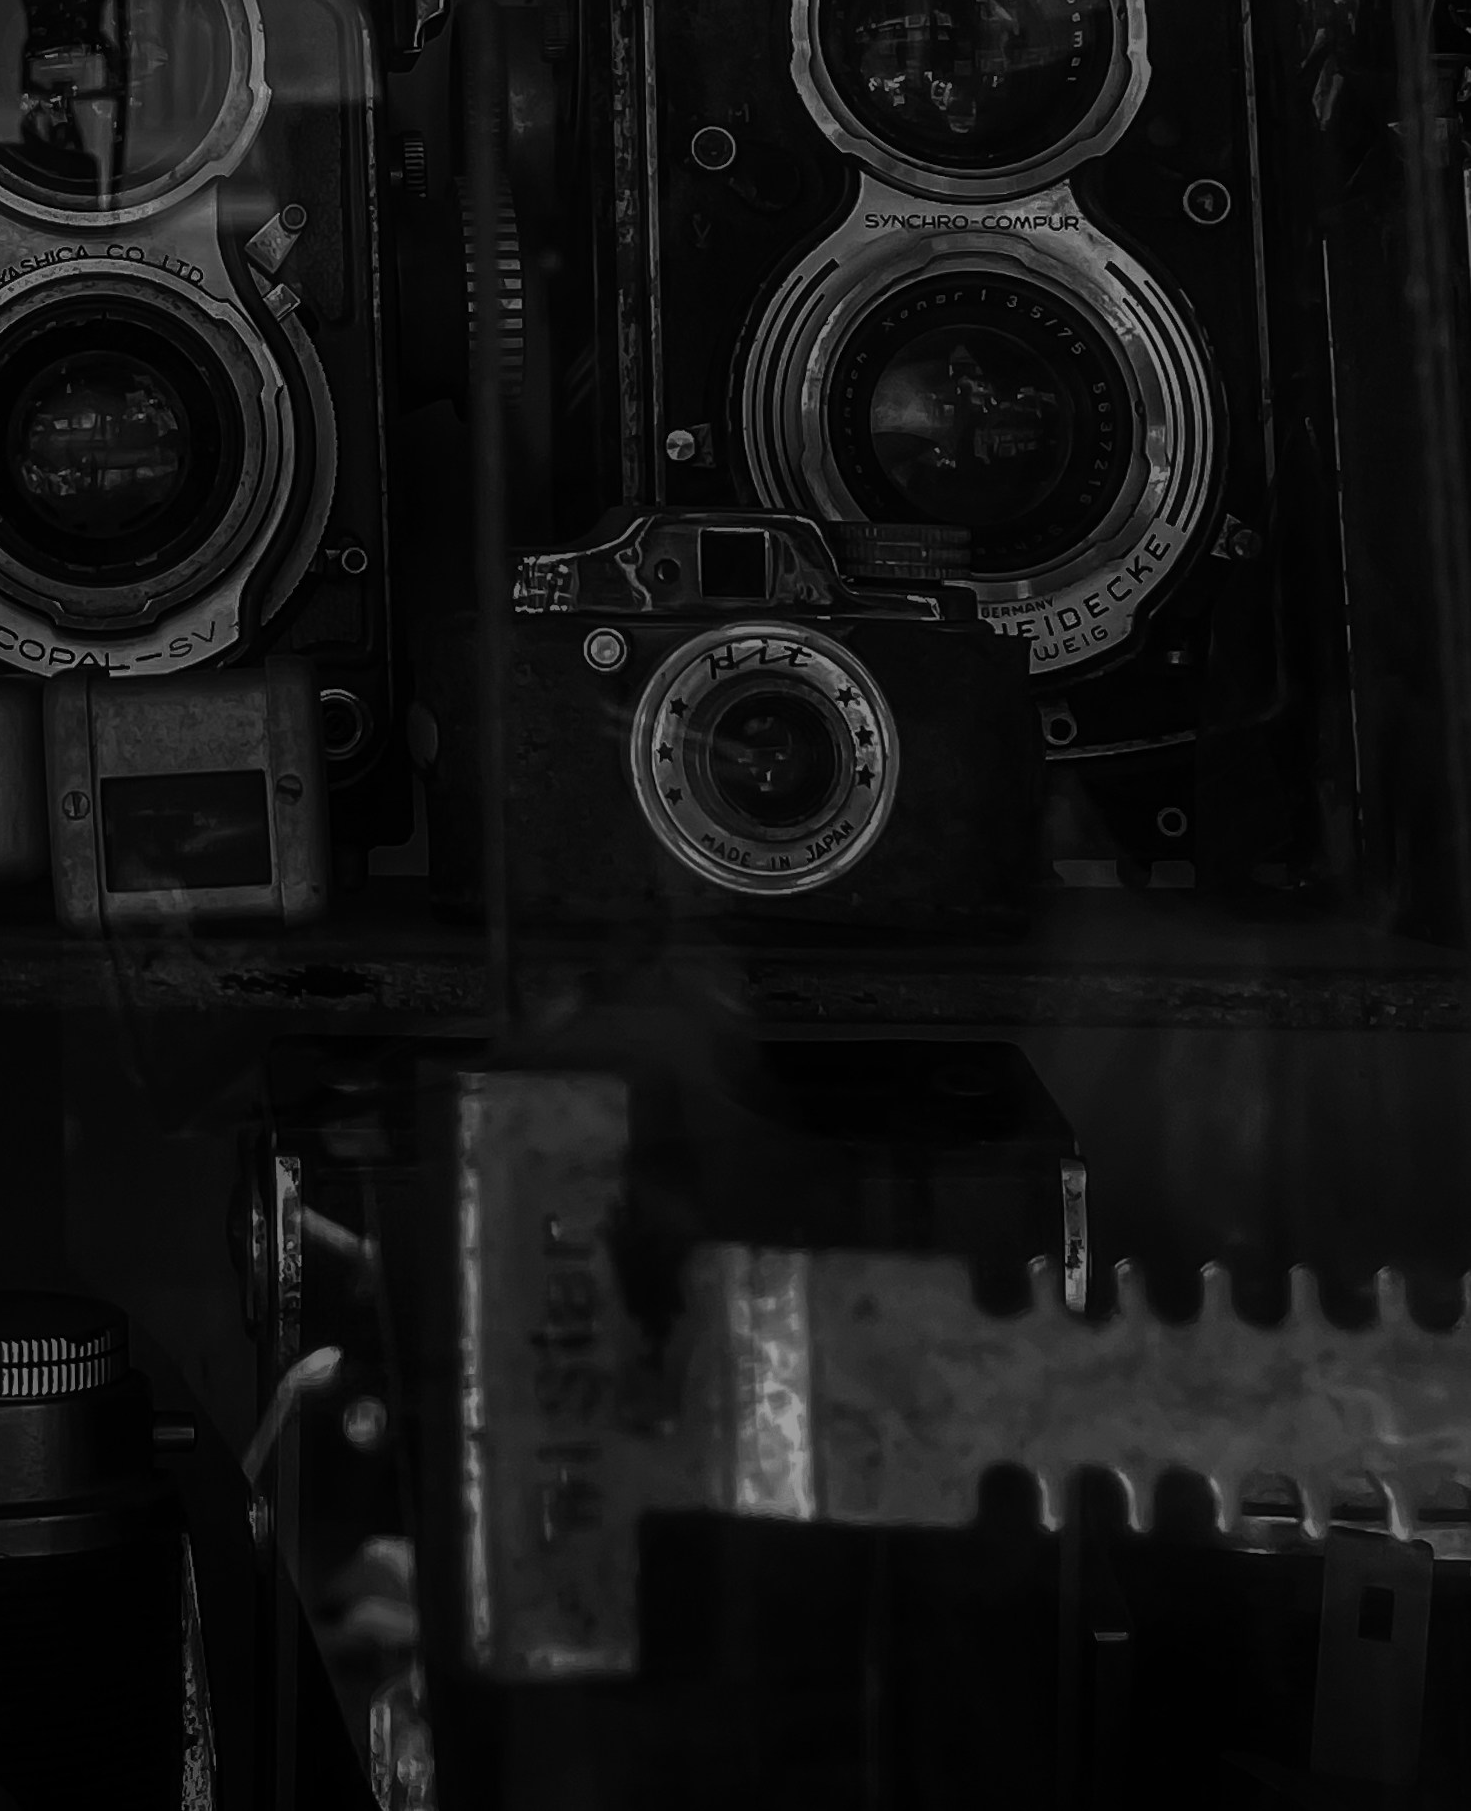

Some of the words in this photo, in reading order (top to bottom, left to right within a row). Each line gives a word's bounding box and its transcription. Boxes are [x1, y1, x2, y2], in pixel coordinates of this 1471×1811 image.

[864, 213, 1080, 232] SYNCHRO-COMPUR
[162, 254, 205, 285] LTD
[1078, 381, 1115, 507] 5637216
[1032, 624, 1109, 662] WEIG
[701, 833, 751, 868] MADE
[770, 856, 791, 870] IN
[805, 819, 855, 863] JAPAN
